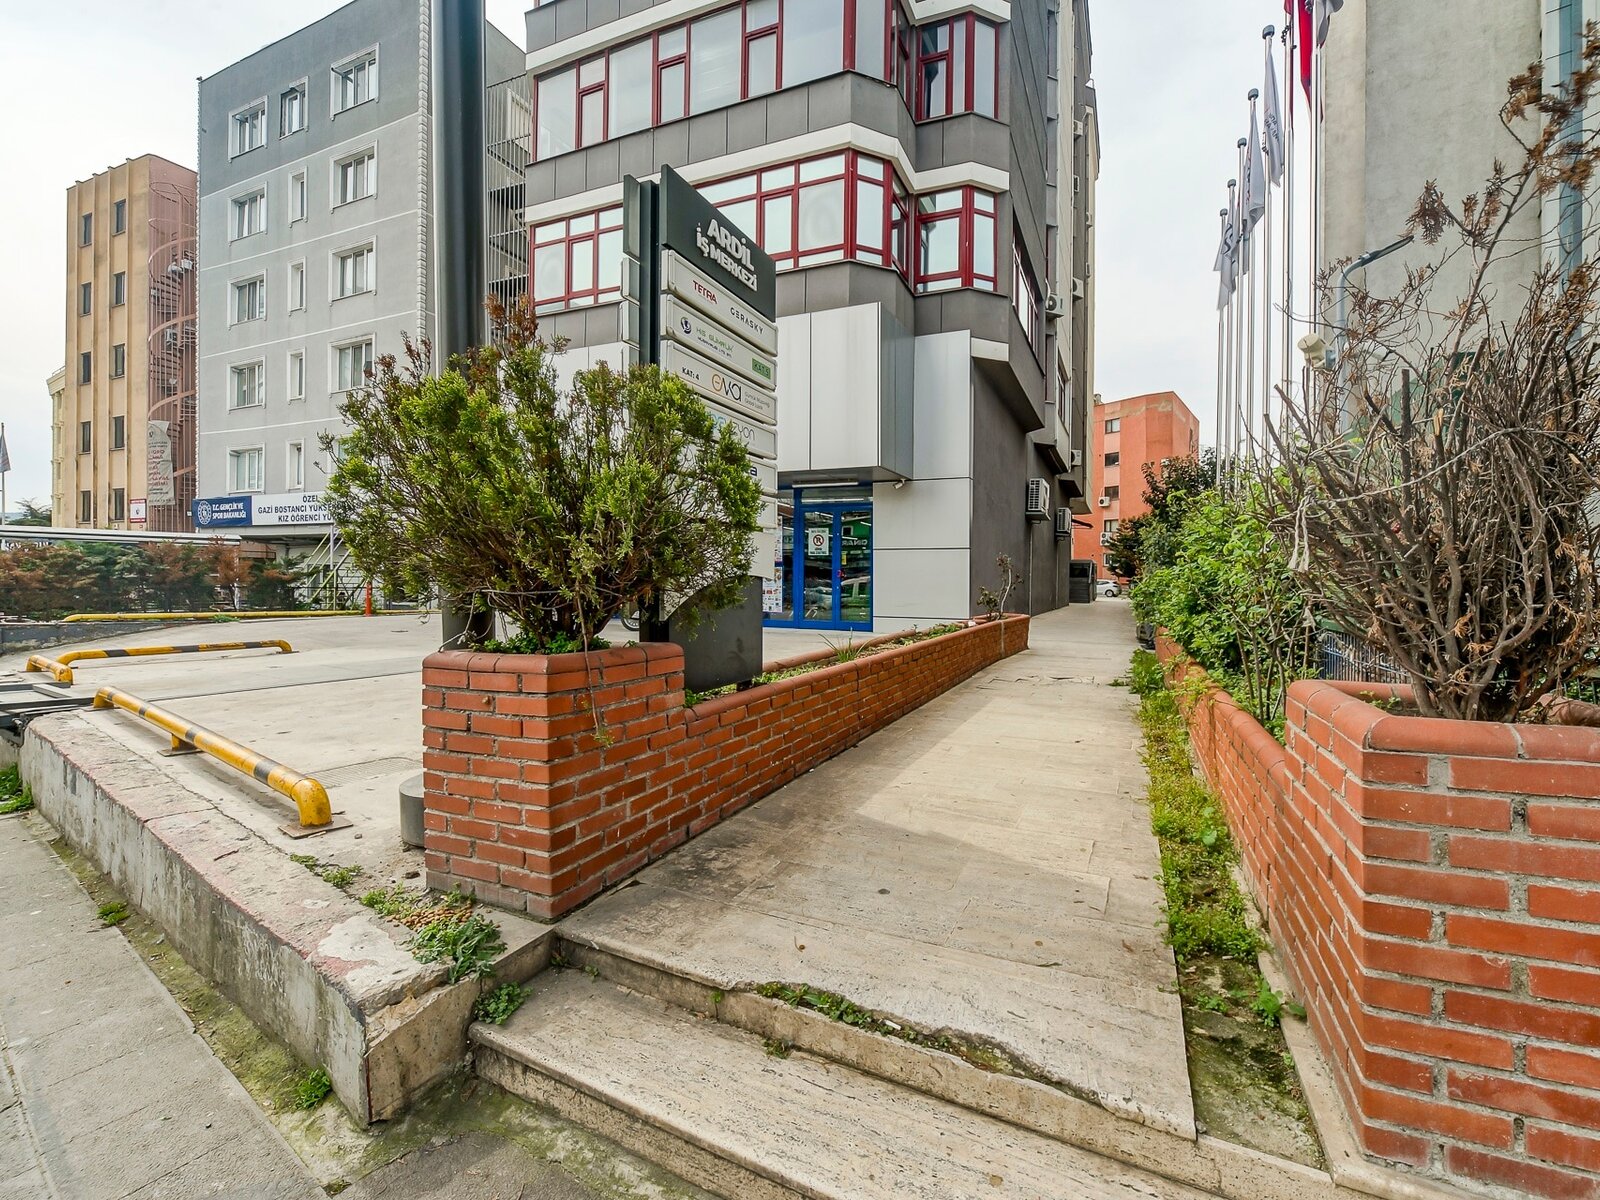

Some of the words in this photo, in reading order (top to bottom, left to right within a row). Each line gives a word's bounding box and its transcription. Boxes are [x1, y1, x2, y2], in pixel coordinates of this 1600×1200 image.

[696, 223, 709, 257] İŞ
[710, 244, 757, 291] MERKEZİ
[707, 219, 754, 271] ARDİL
[693, 280, 717, 304] TETRA
[730, 307, 764, 334] CERASKY
[258, 505, 272, 514] GAZİ
[274, 505, 306, 514] BOSTANCI
[290, 513, 321, 522] ÖĞRENCİ
